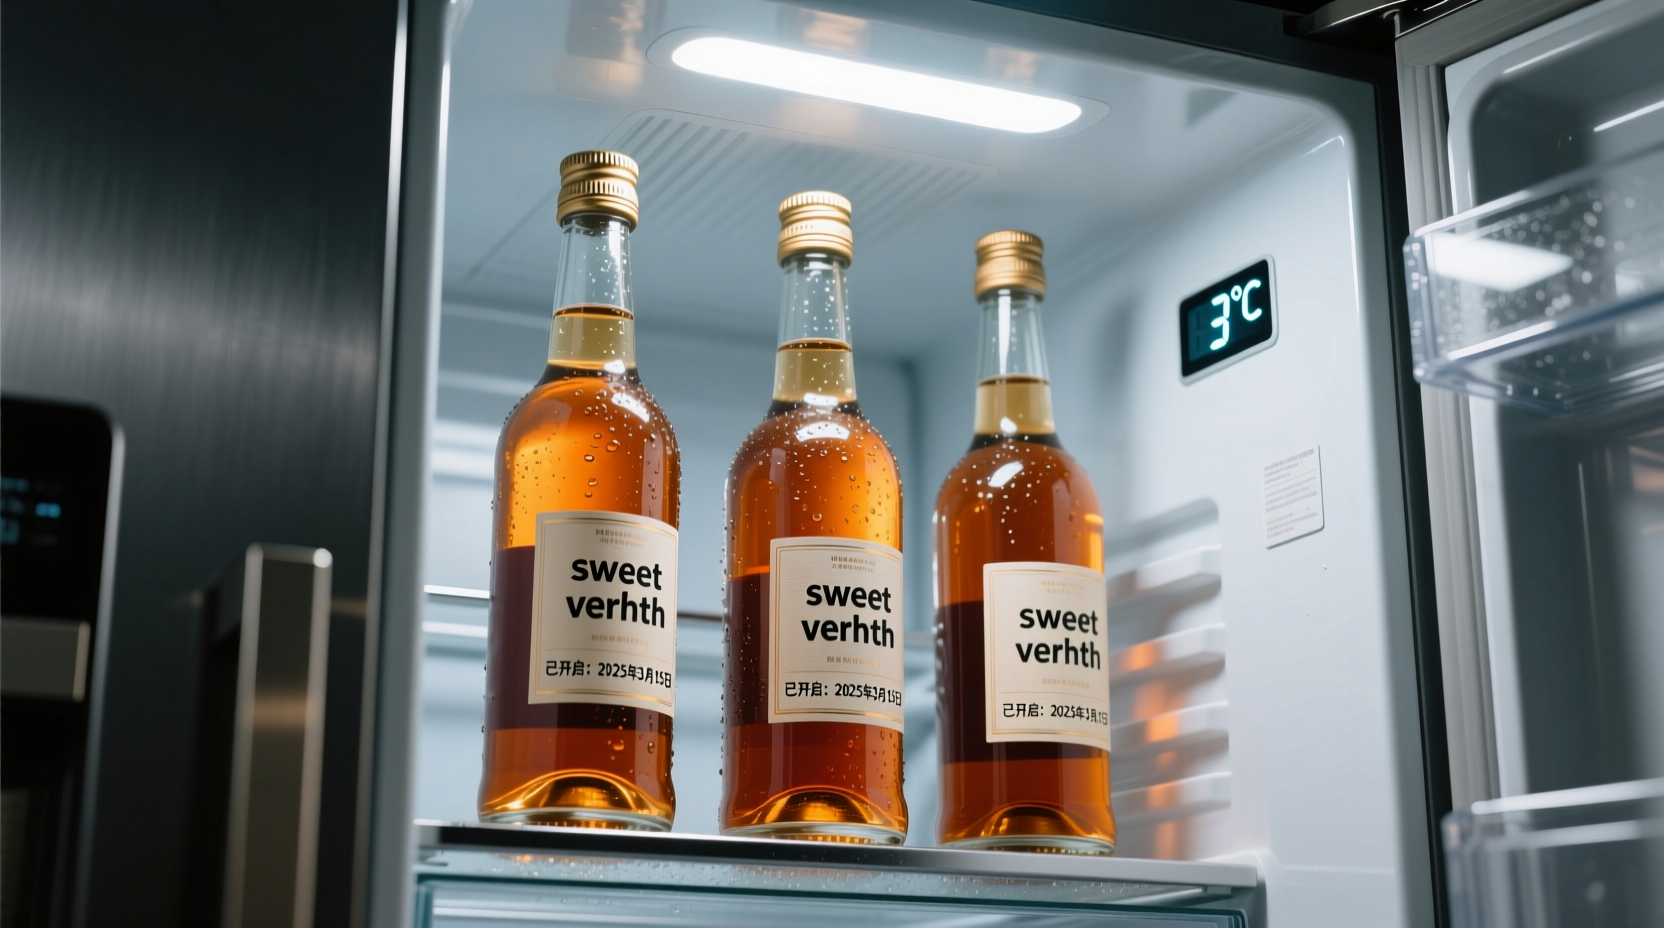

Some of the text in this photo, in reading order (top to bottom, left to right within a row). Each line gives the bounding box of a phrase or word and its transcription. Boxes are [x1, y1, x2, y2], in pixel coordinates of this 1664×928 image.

[570, 558, 663, 591] sweet
[565, 590, 666, 629] verhth
[806, 584, 892, 614] sweet
[801, 614, 895, 649] verhth
[1019, 608, 1099, 636] sweet
[1015, 637, 1101, 671] verhth
